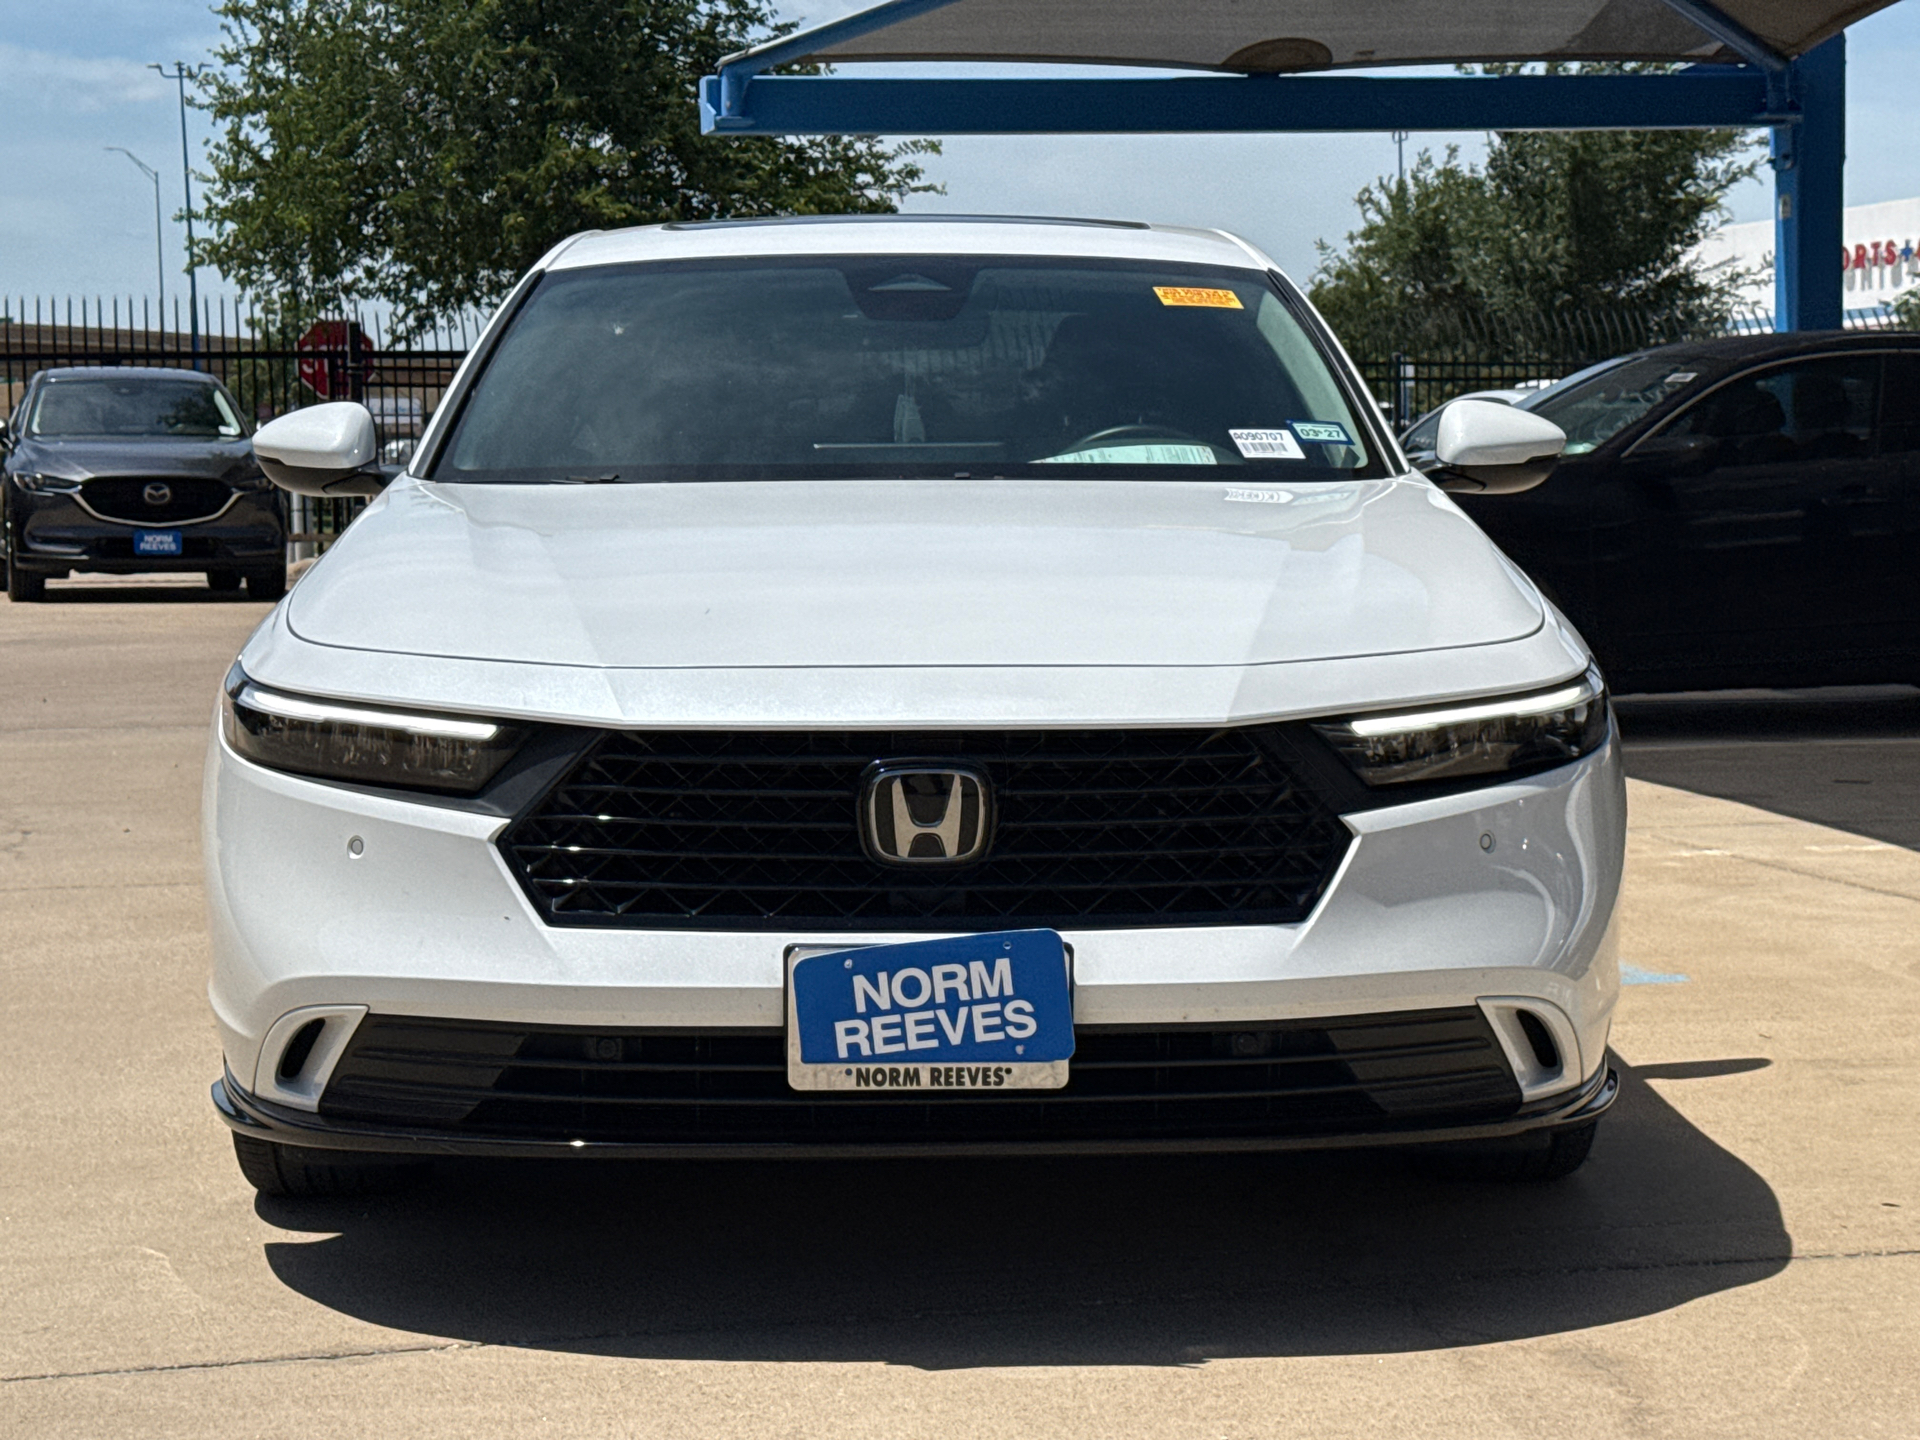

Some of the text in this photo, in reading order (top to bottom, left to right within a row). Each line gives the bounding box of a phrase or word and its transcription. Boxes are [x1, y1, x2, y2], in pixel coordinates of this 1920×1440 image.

[852, 957, 1014, 1013] NORM
[834, 999, 1037, 1058] REEVES
[855, 1067, 1005, 1087] NORM REEVES
